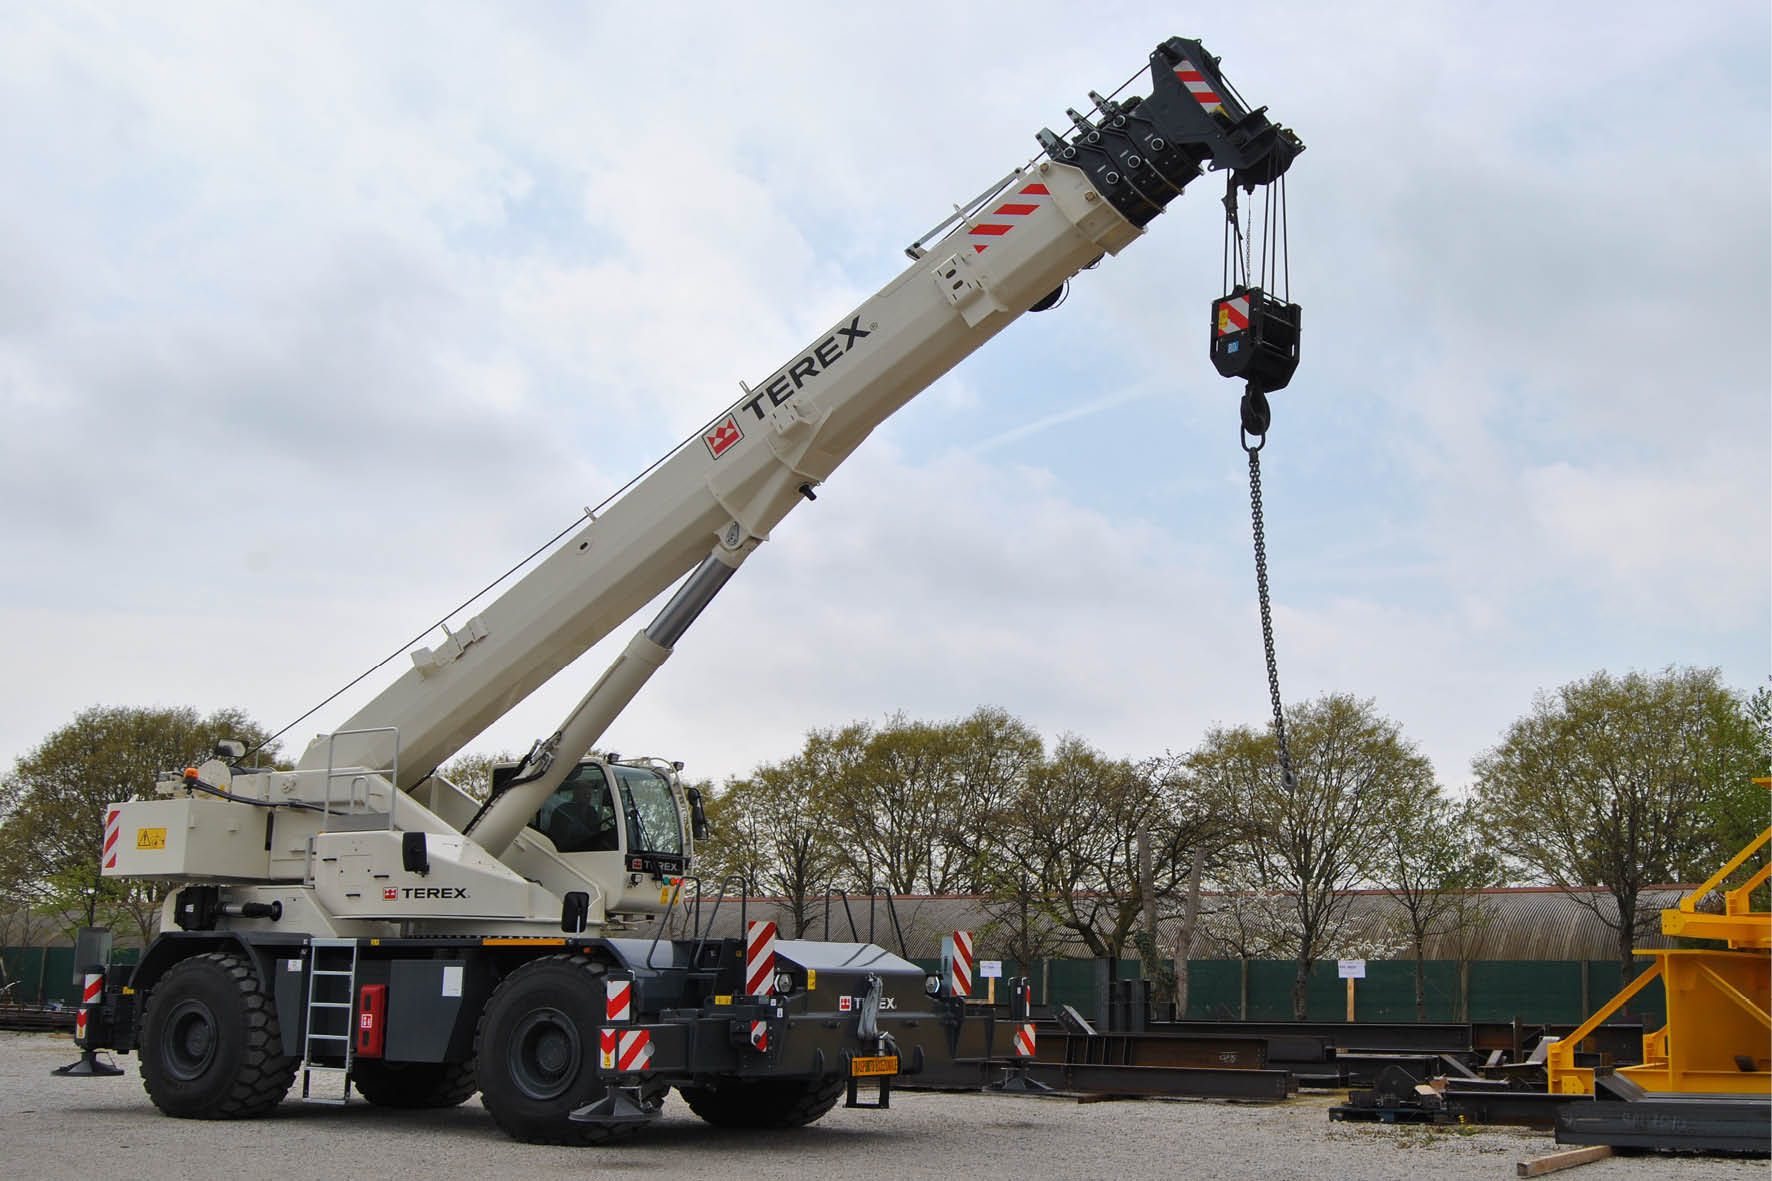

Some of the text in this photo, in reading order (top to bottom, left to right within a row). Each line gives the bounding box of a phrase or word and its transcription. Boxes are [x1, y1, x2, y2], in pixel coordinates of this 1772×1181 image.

[742, 314, 872, 421] TEREX
[643, 860, 678, 872] TREX
[401, 887, 467, 899] TEREX
[853, 997, 895, 1009] TEX
